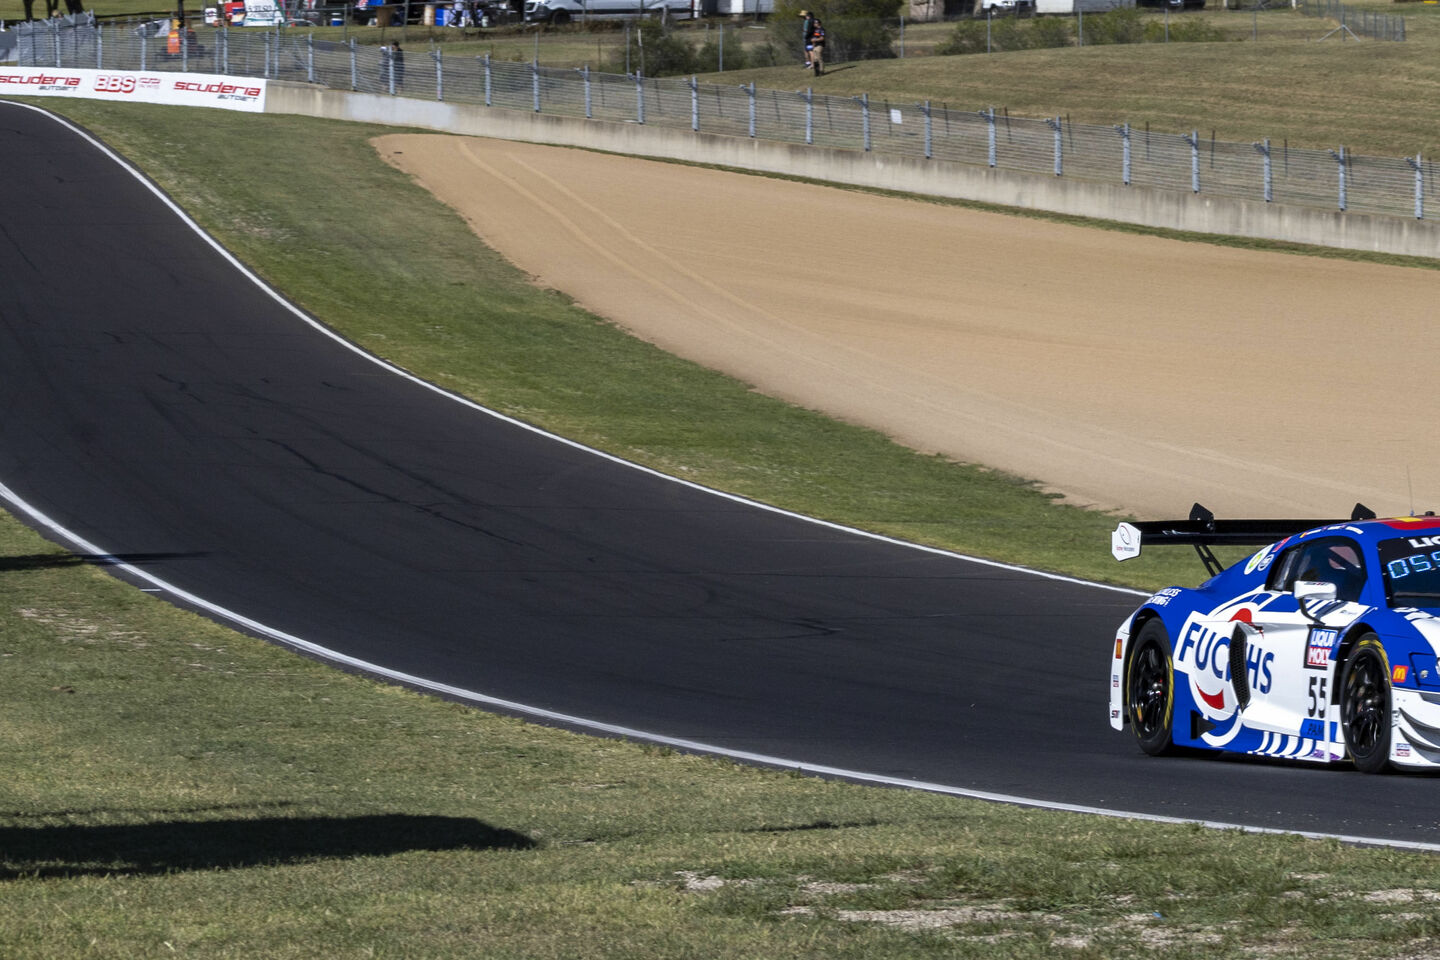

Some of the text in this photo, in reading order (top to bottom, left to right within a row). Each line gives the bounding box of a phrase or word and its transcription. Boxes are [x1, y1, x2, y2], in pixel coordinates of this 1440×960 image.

[93, 75, 137, 94] BBS
[173, 81, 262, 97] scuderia
[1310, 629, 1336, 647] LIQUI
[1178, 621, 1275, 695] FUCHS
[1307, 675, 1328, 719] 55
